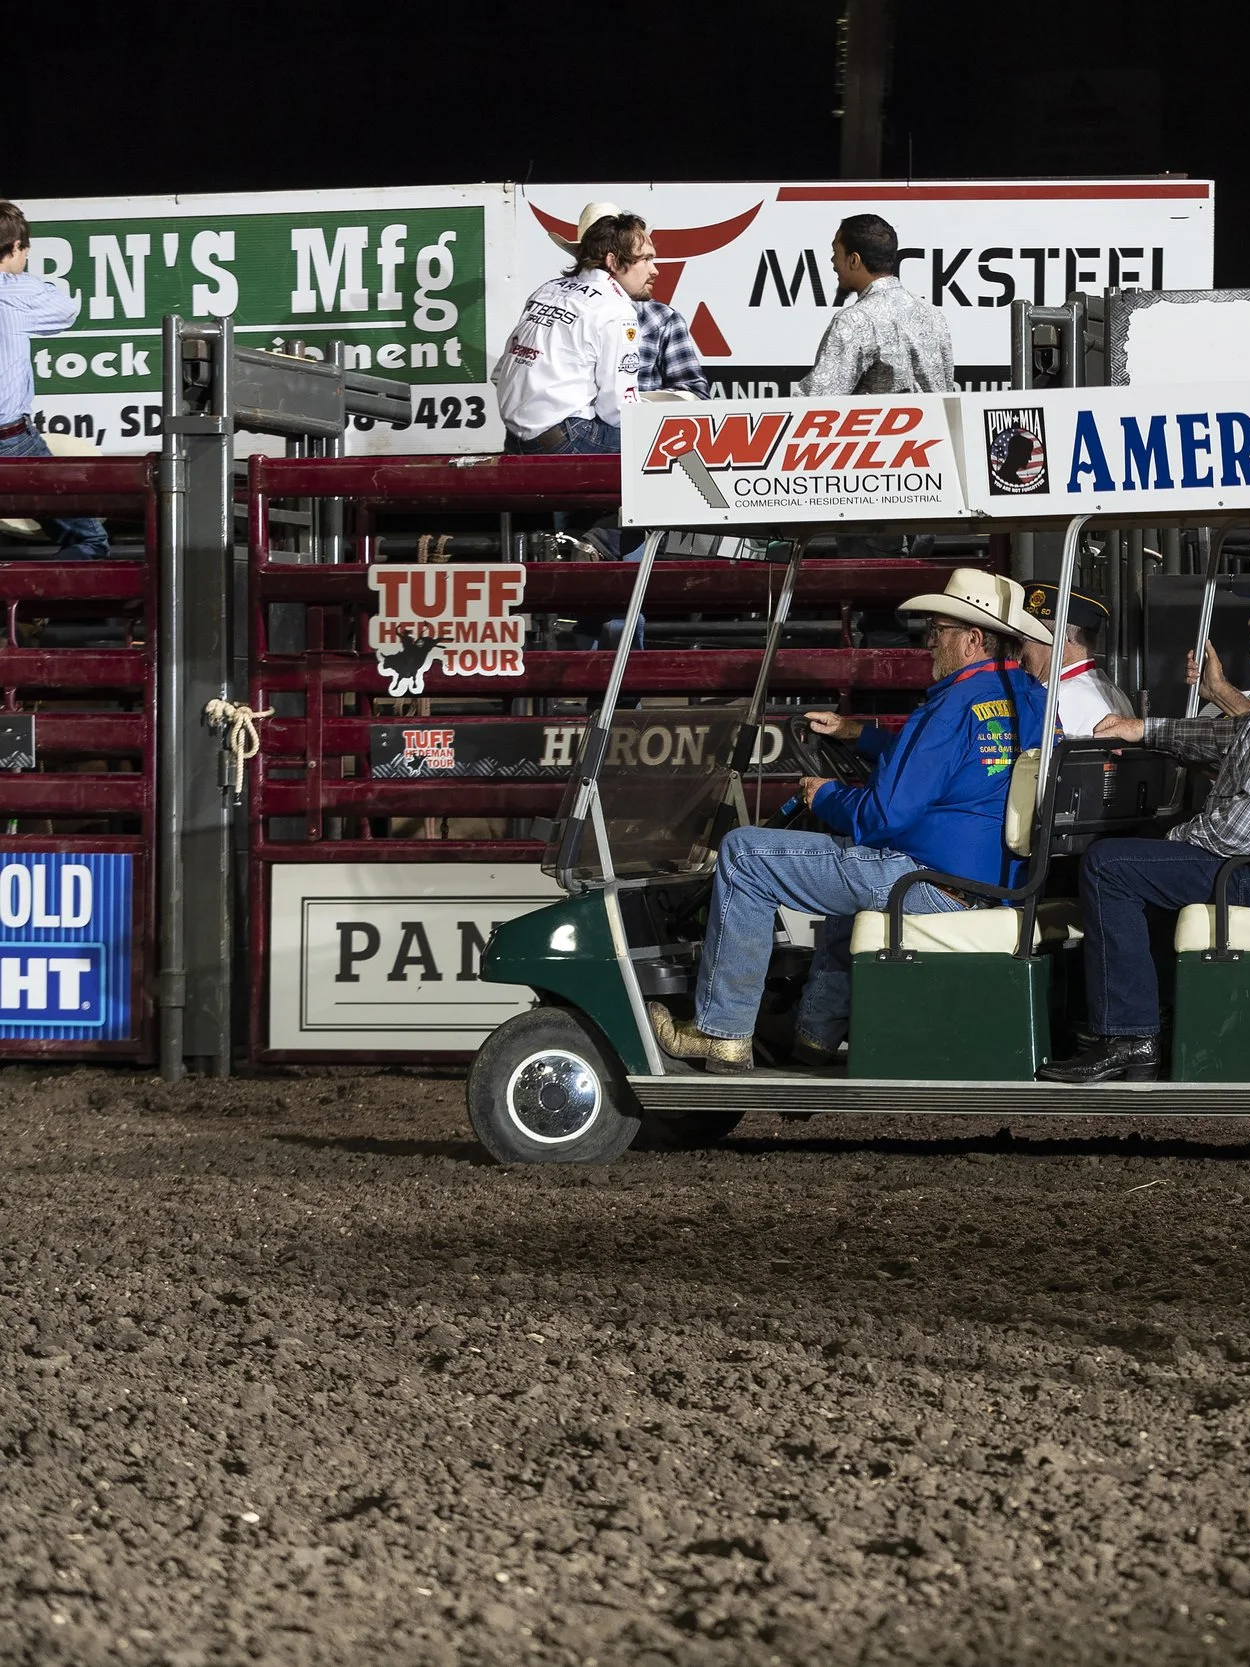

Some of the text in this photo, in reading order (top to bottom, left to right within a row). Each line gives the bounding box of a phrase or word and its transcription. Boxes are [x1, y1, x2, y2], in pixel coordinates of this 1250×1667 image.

[291, 224, 459, 332] Mfg
[555, 280, 602, 298] ARIAT
[121, 405, 163, 437] SD
[792, 407, 924, 439] RED
[987, 409, 1042, 446] POW MIA
[781, 439, 944, 472] WILK
[733, 473, 943, 497] CONSTRUCTION
[735, 494, 942, 508] COMMERCIAL RESIDENTIAL INDUSTRIAL
[377, 571, 521, 618] TUFF
[379, 621, 519, 644] HEDEMAN
[443, 649, 519, 671] TOUR
[403, 731, 454, 749] TUFF
[427, 759, 454, 768] TOUR
[0, 863, 92, 928] OLD
